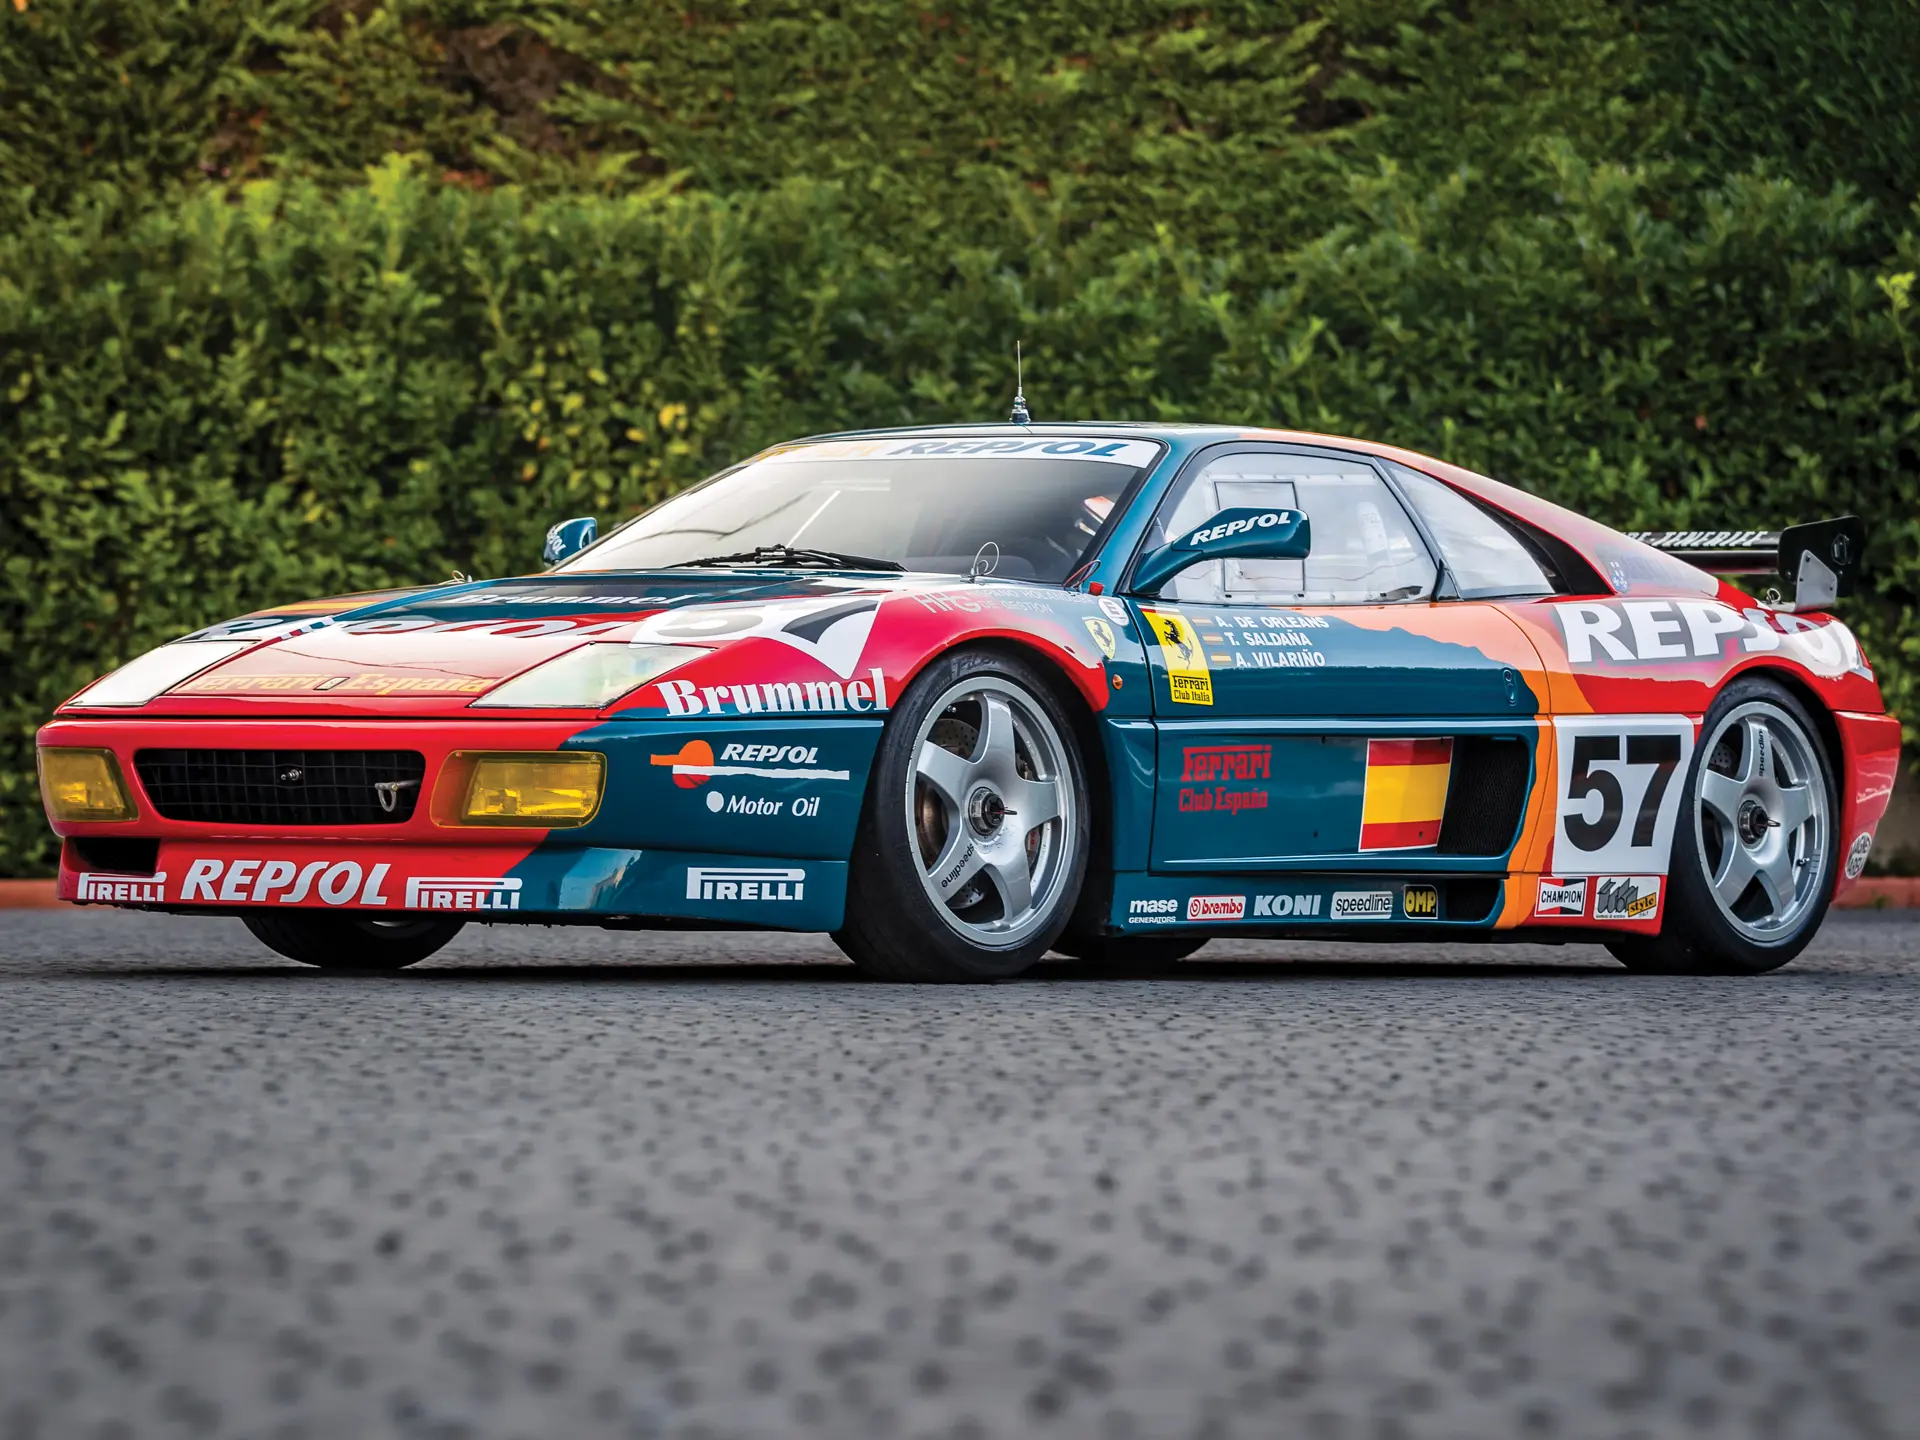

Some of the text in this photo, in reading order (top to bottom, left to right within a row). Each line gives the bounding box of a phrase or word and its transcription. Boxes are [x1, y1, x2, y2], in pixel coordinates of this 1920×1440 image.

[887, 441, 1129, 457] REPSOL
[1190, 511, 1290, 546] REPSOL
[1215, 616, 1330, 629] A. DE ORLEANS
[1224, 629, 1313, 646] T. SALDAÑA
[1235, 649, 1326, 668] A. VILARIÑO
[652, 667, 889, 717] Brummel
[1172, 675, 1209, 690] Ferrari
[1174, 690, 1211, 702] Club Italia
[720, 743, 819, 764] REPSOL
[1181, 744, 1272, 782] Ferrari
[1179, 786, 1268, 815] Club España
[1563, 735, 1682, 852] 57
[726, 795, 821, 817] Motor Oil
[941, 843, 975, 888] speedline
[77, 872, 167, 902] PIRELLI
[180, 859, 391, 906] REPSOL
[405, 876, 523, 910] PIRELLI
[686, 867, 806, 901] PIRELLI
[1129, 899, 1179, 913] mase
[1201, 898, 1243, 914] brembo
[1253, 894, 1321, 916] KONI
[1335, 893, 1391, 917] speedline
[1405, 890, 1437, 914] OMP
[1541, 890, 1582, 903] CHAMPION
[1128, 916, 1176, 924] GENERATORS
